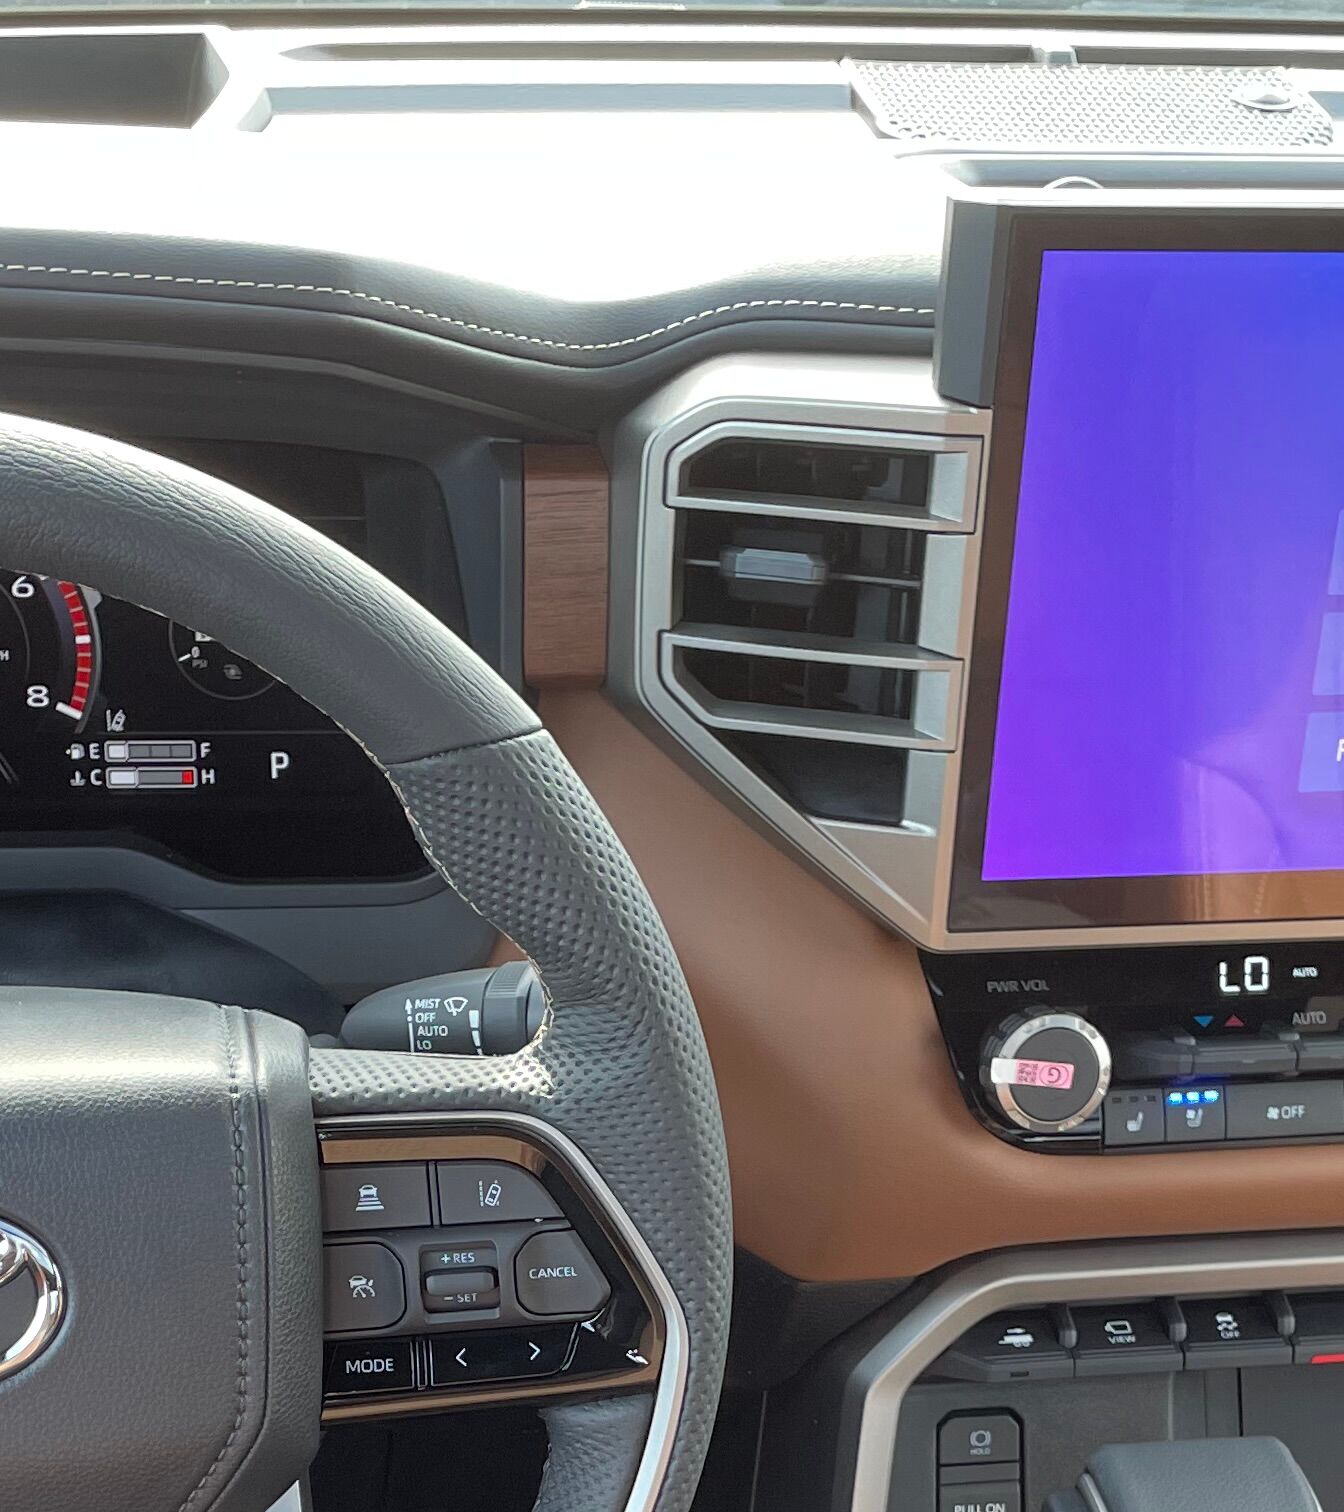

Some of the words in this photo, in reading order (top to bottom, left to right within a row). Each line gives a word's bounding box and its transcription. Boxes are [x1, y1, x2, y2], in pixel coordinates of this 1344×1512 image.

[11, 575, 35, 598] 6
[26, 685, 51, 707] 8
[90, 744, 100, 760] E
[200, 744, 212, 759] F
[270, 752, 291, 779] P
[90, 769, 103, 785] C
[201, 769, 214, 785] H
[1219, 956, 1270, 992] LO
[1292, 967, 1318, 978] AUTO
[986, 980, 1019, 993] PWR
[1021, 979, 1050, 992] VOL
[414, 998, 441, 1009] MIST
[415, 1012, 436, 1023] OFF
[1292, 1011, 1327, 1026] AUTO
[417, 1025, 449, 1037] AUTO
[416, 1039, 432, 1050] LO
[1280, 1106, 1306, 1119] OFF
[528, 1266, 578, 1280] CANCEL
[1107, 1335, 1137, 1345] VIEW
[345, 1358, 395, 1374] MODE
